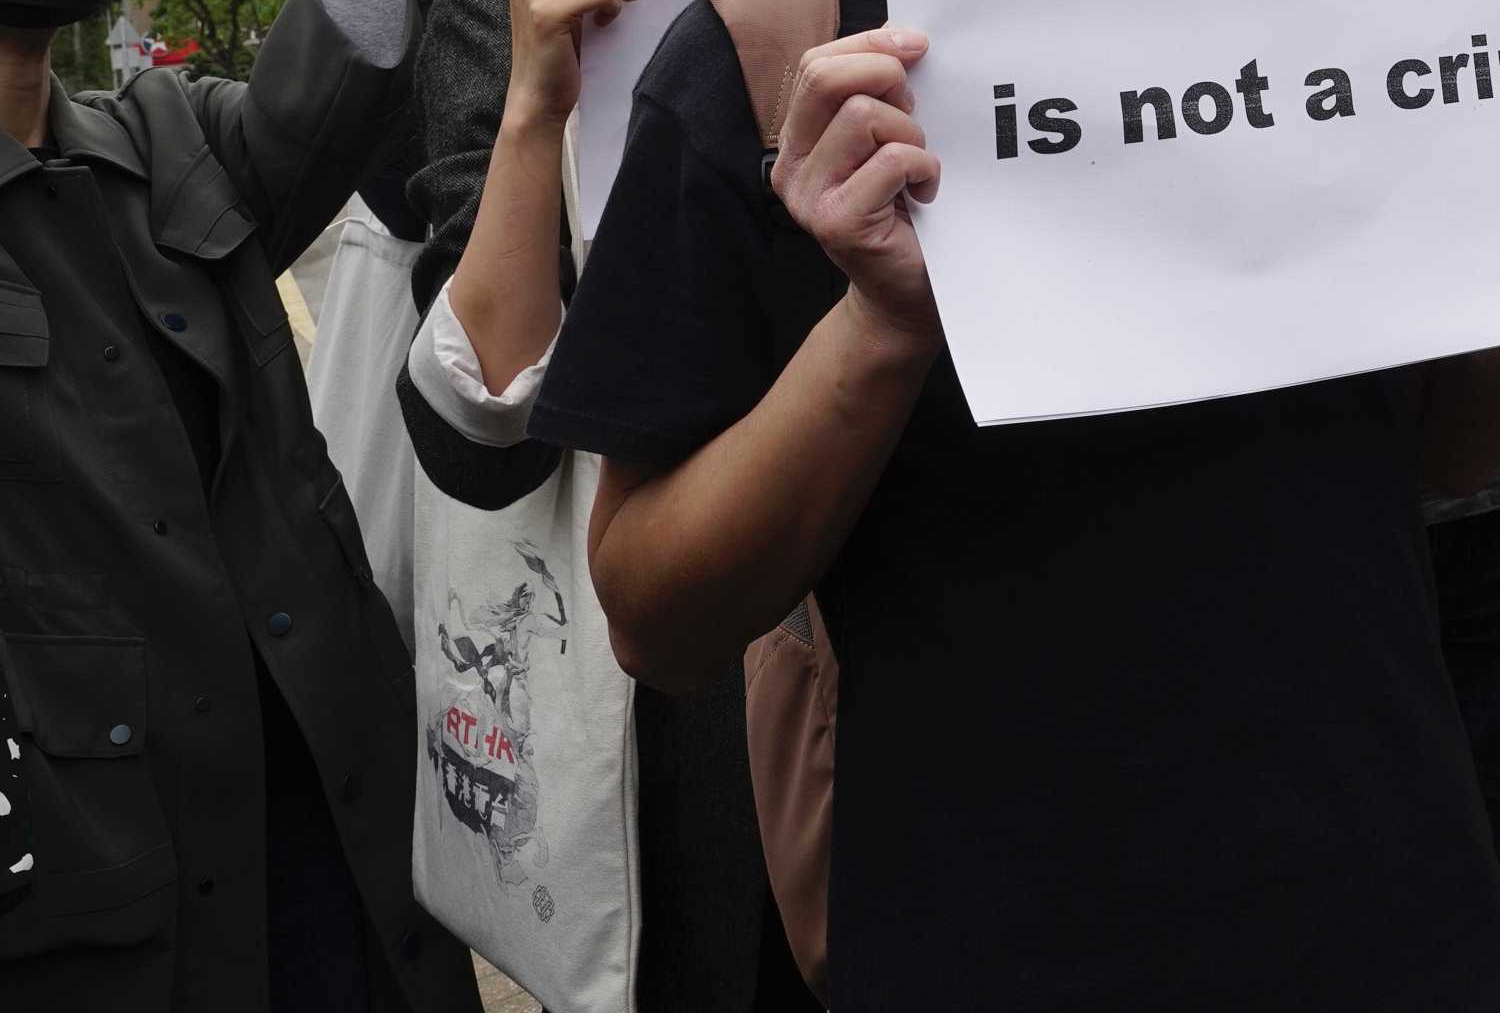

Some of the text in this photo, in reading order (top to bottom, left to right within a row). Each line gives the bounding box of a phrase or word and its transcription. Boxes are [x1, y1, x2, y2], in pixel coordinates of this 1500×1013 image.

[993, 84, 1082, 159] is
[1120, 58, 1274, 144] not
[1304, 68, 1356, 121] a
